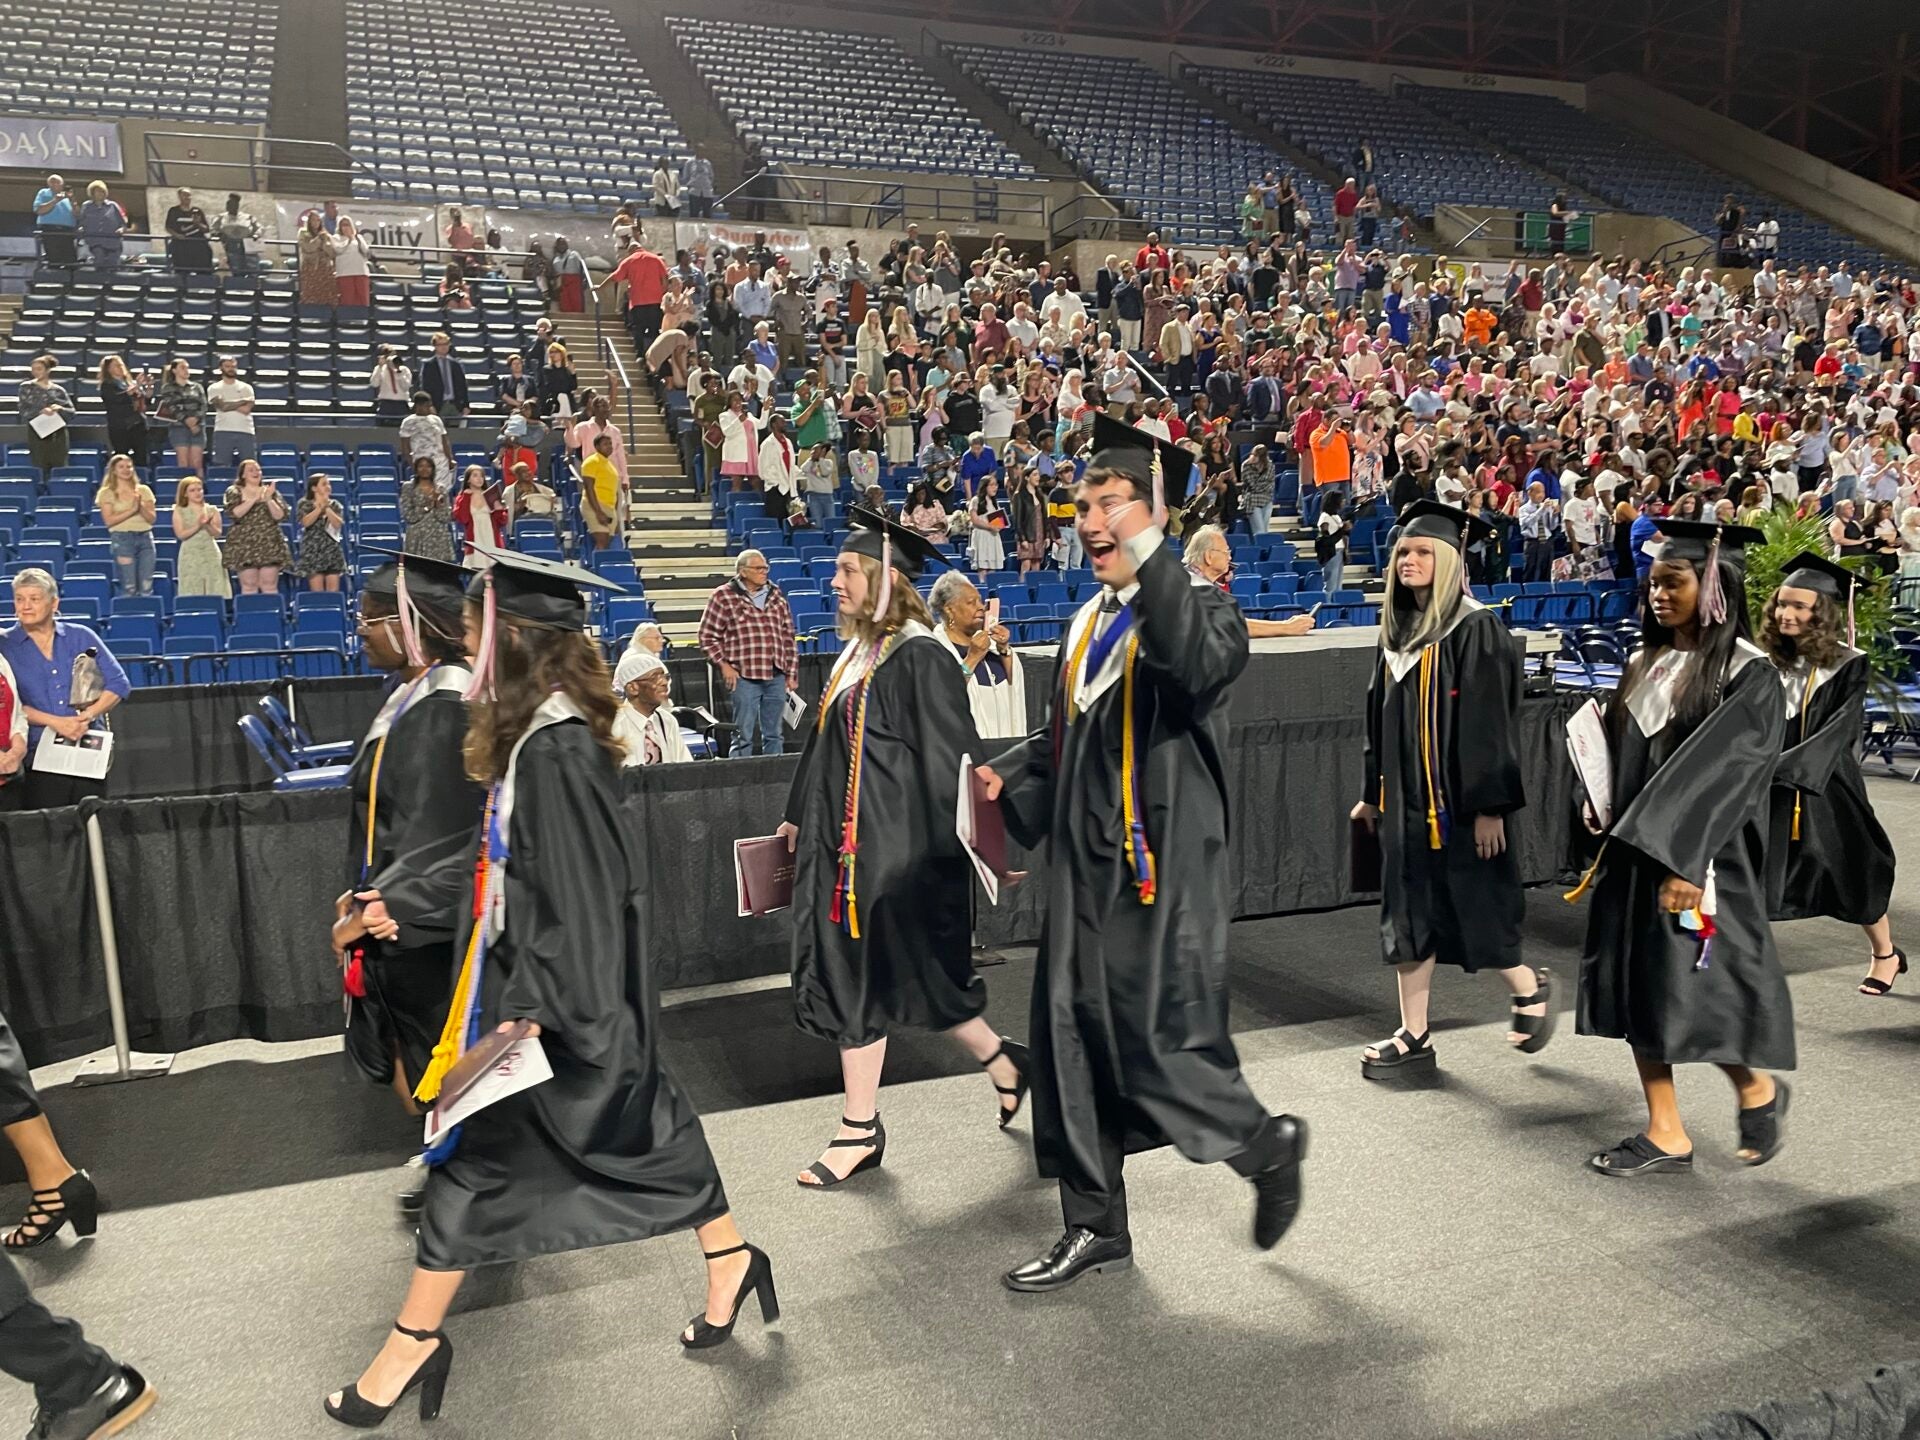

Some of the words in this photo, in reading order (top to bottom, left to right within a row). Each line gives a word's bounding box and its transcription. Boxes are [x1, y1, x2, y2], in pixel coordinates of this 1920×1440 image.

[1031, 32, 1055, 46] 223
[0, 126, 106, 161] DASANI
[715, 226, 799, 246] Dumster
